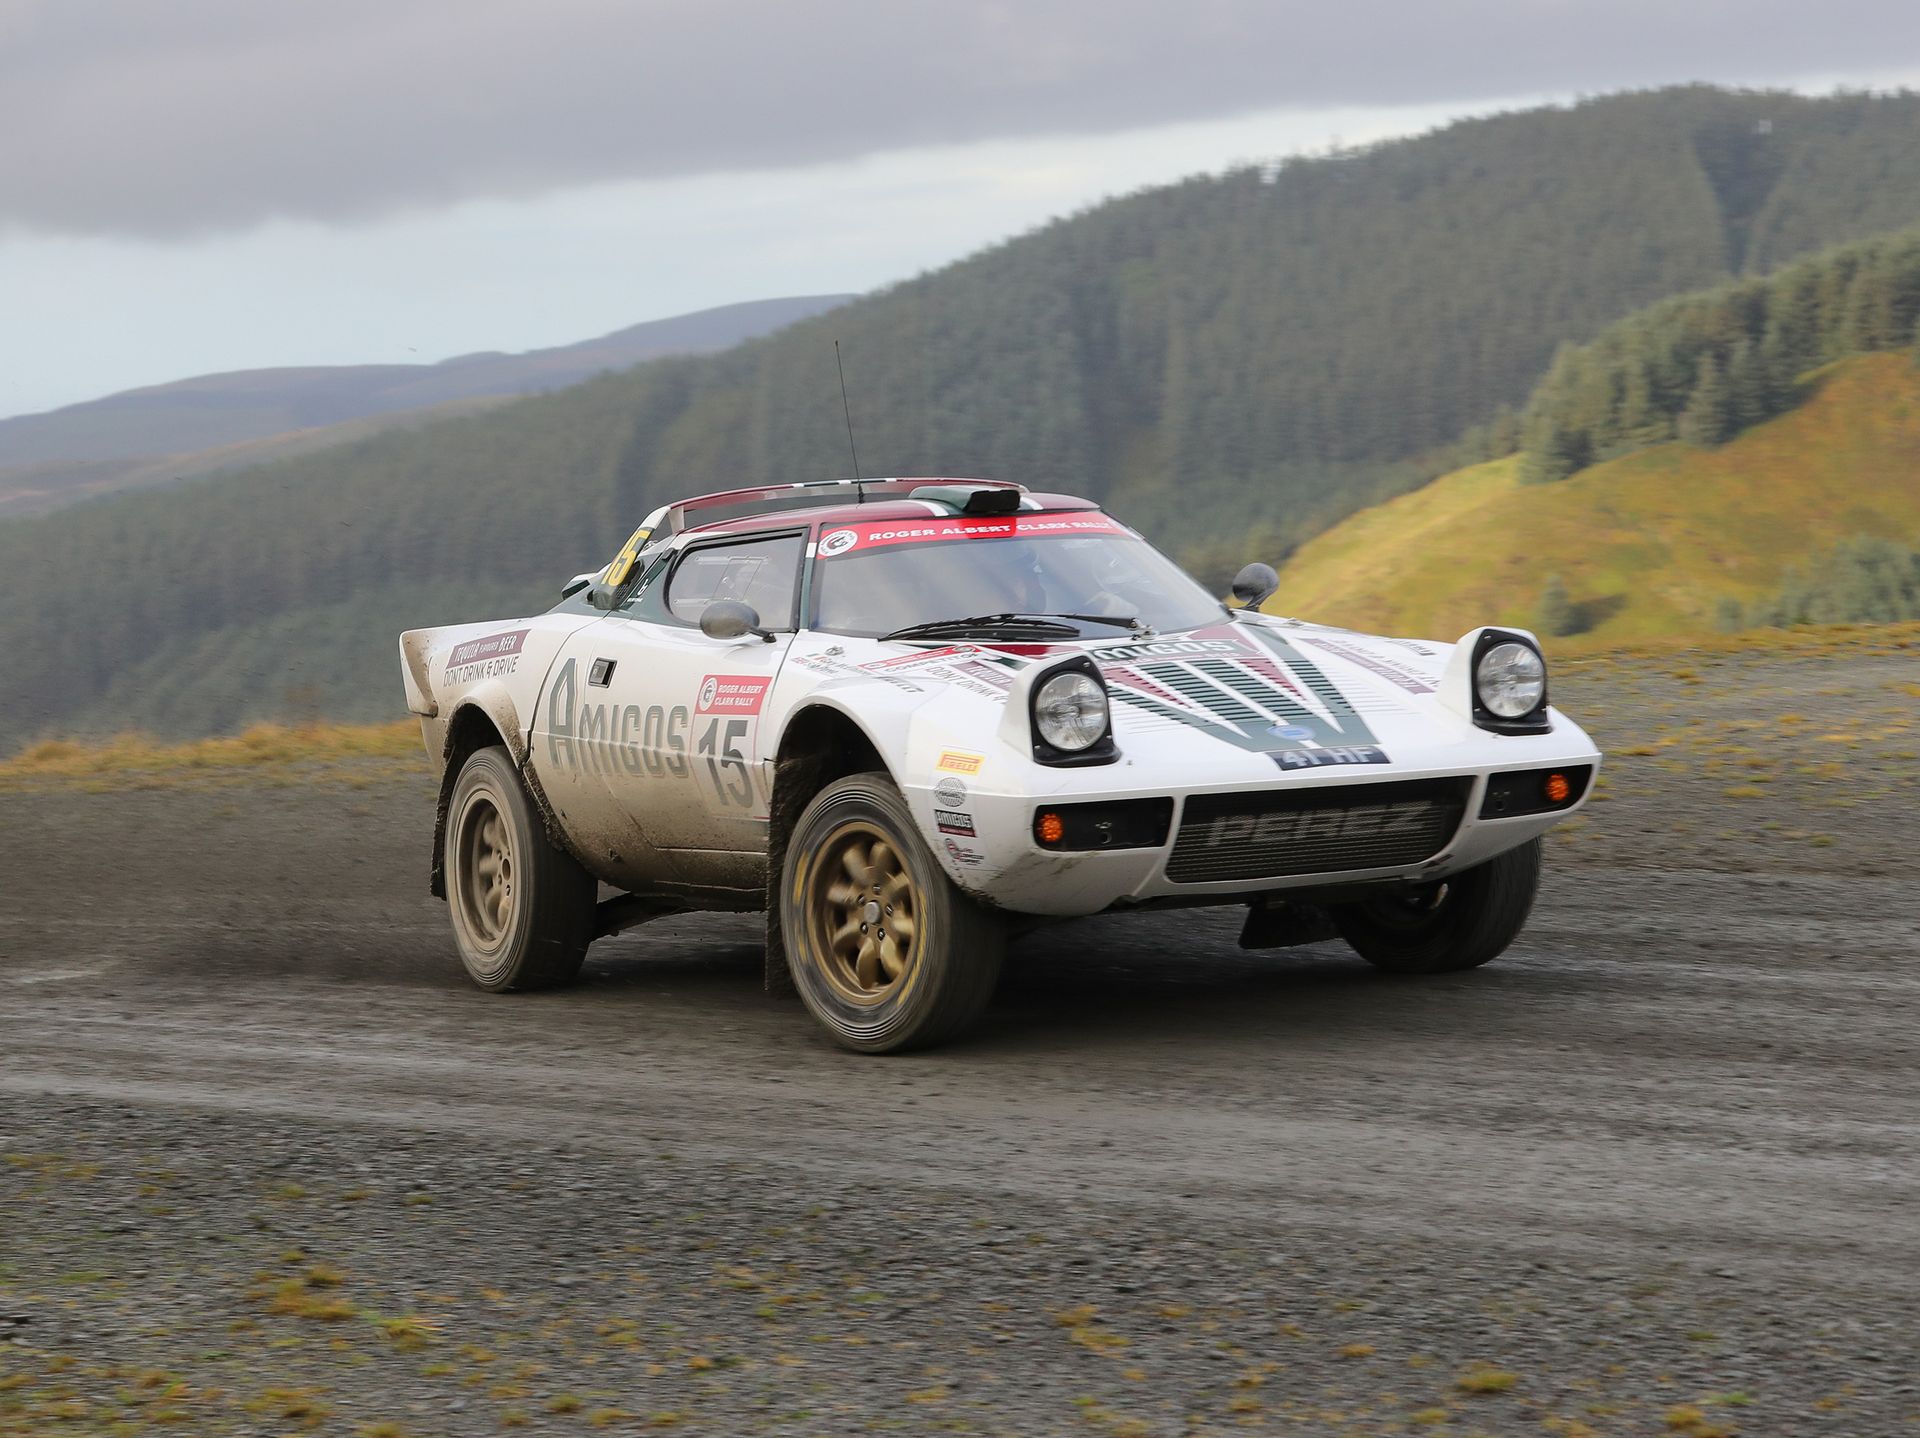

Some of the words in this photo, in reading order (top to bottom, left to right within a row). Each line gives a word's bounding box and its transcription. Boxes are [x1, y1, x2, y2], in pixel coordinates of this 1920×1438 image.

[869, 527, 936, 541] ROGER
[941, 524, 1011, 535] ALBERT
[1016, 521, 1071, 531] CLARK
[498, 635, 517, 652] BEER
[1094, 640, 1235, 660] MIGOS
[462, 661, 487, 682] DRINK
[493, 656, 519, 676] DRIVE
[717, 684, 739, 694] ROGER
[739, 685, 763, 694] ALBERT
[714, 697, 735, 706] CLARK
[698, 718, 753, 808] 15
[1208, 801, 1432, 847] PEREZ
